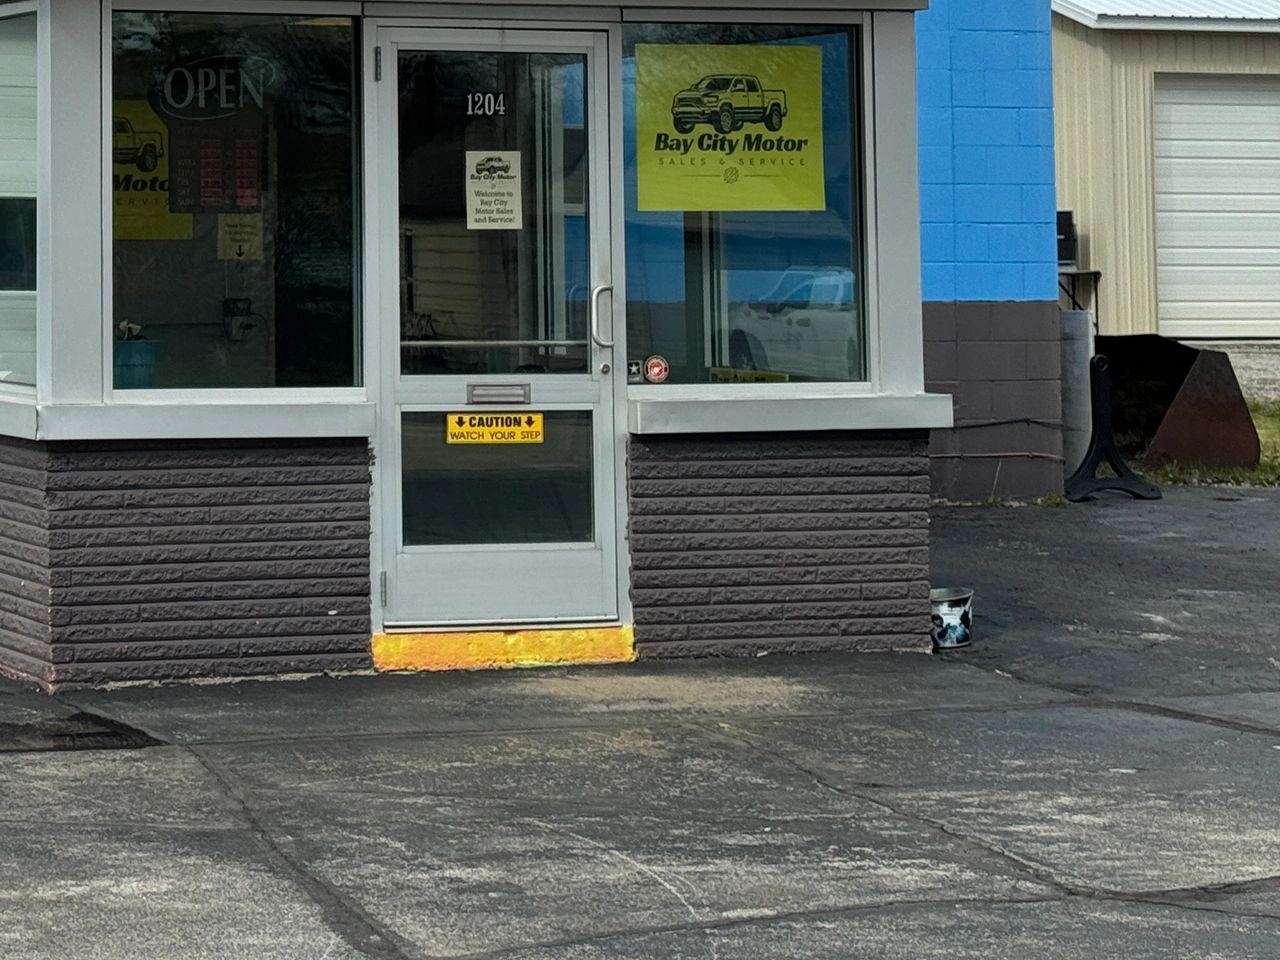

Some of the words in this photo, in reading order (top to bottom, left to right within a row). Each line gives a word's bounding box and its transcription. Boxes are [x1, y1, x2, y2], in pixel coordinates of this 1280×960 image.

[164, 67, 265, 109] OPEN
[466, 93, 506, 116] 1204
[655, 133, 694, 155] Bay
[698, 133, 739, 155] City
[742, 134, 808, 152] Motor
[658, 157, 707, 166] SALES
[719, 158, 725, 166] &
[739, 157, 806, 166] SERVICE
[113, 174, 170, 191] Moto
[493, 199, 508, 207] City
[469, 416, 521, 428] CAUTION
[450, 431, 484, 440] WATCH
[489, 431, 516, 440] YOUR
[521, 431, 541, 440] STEP
